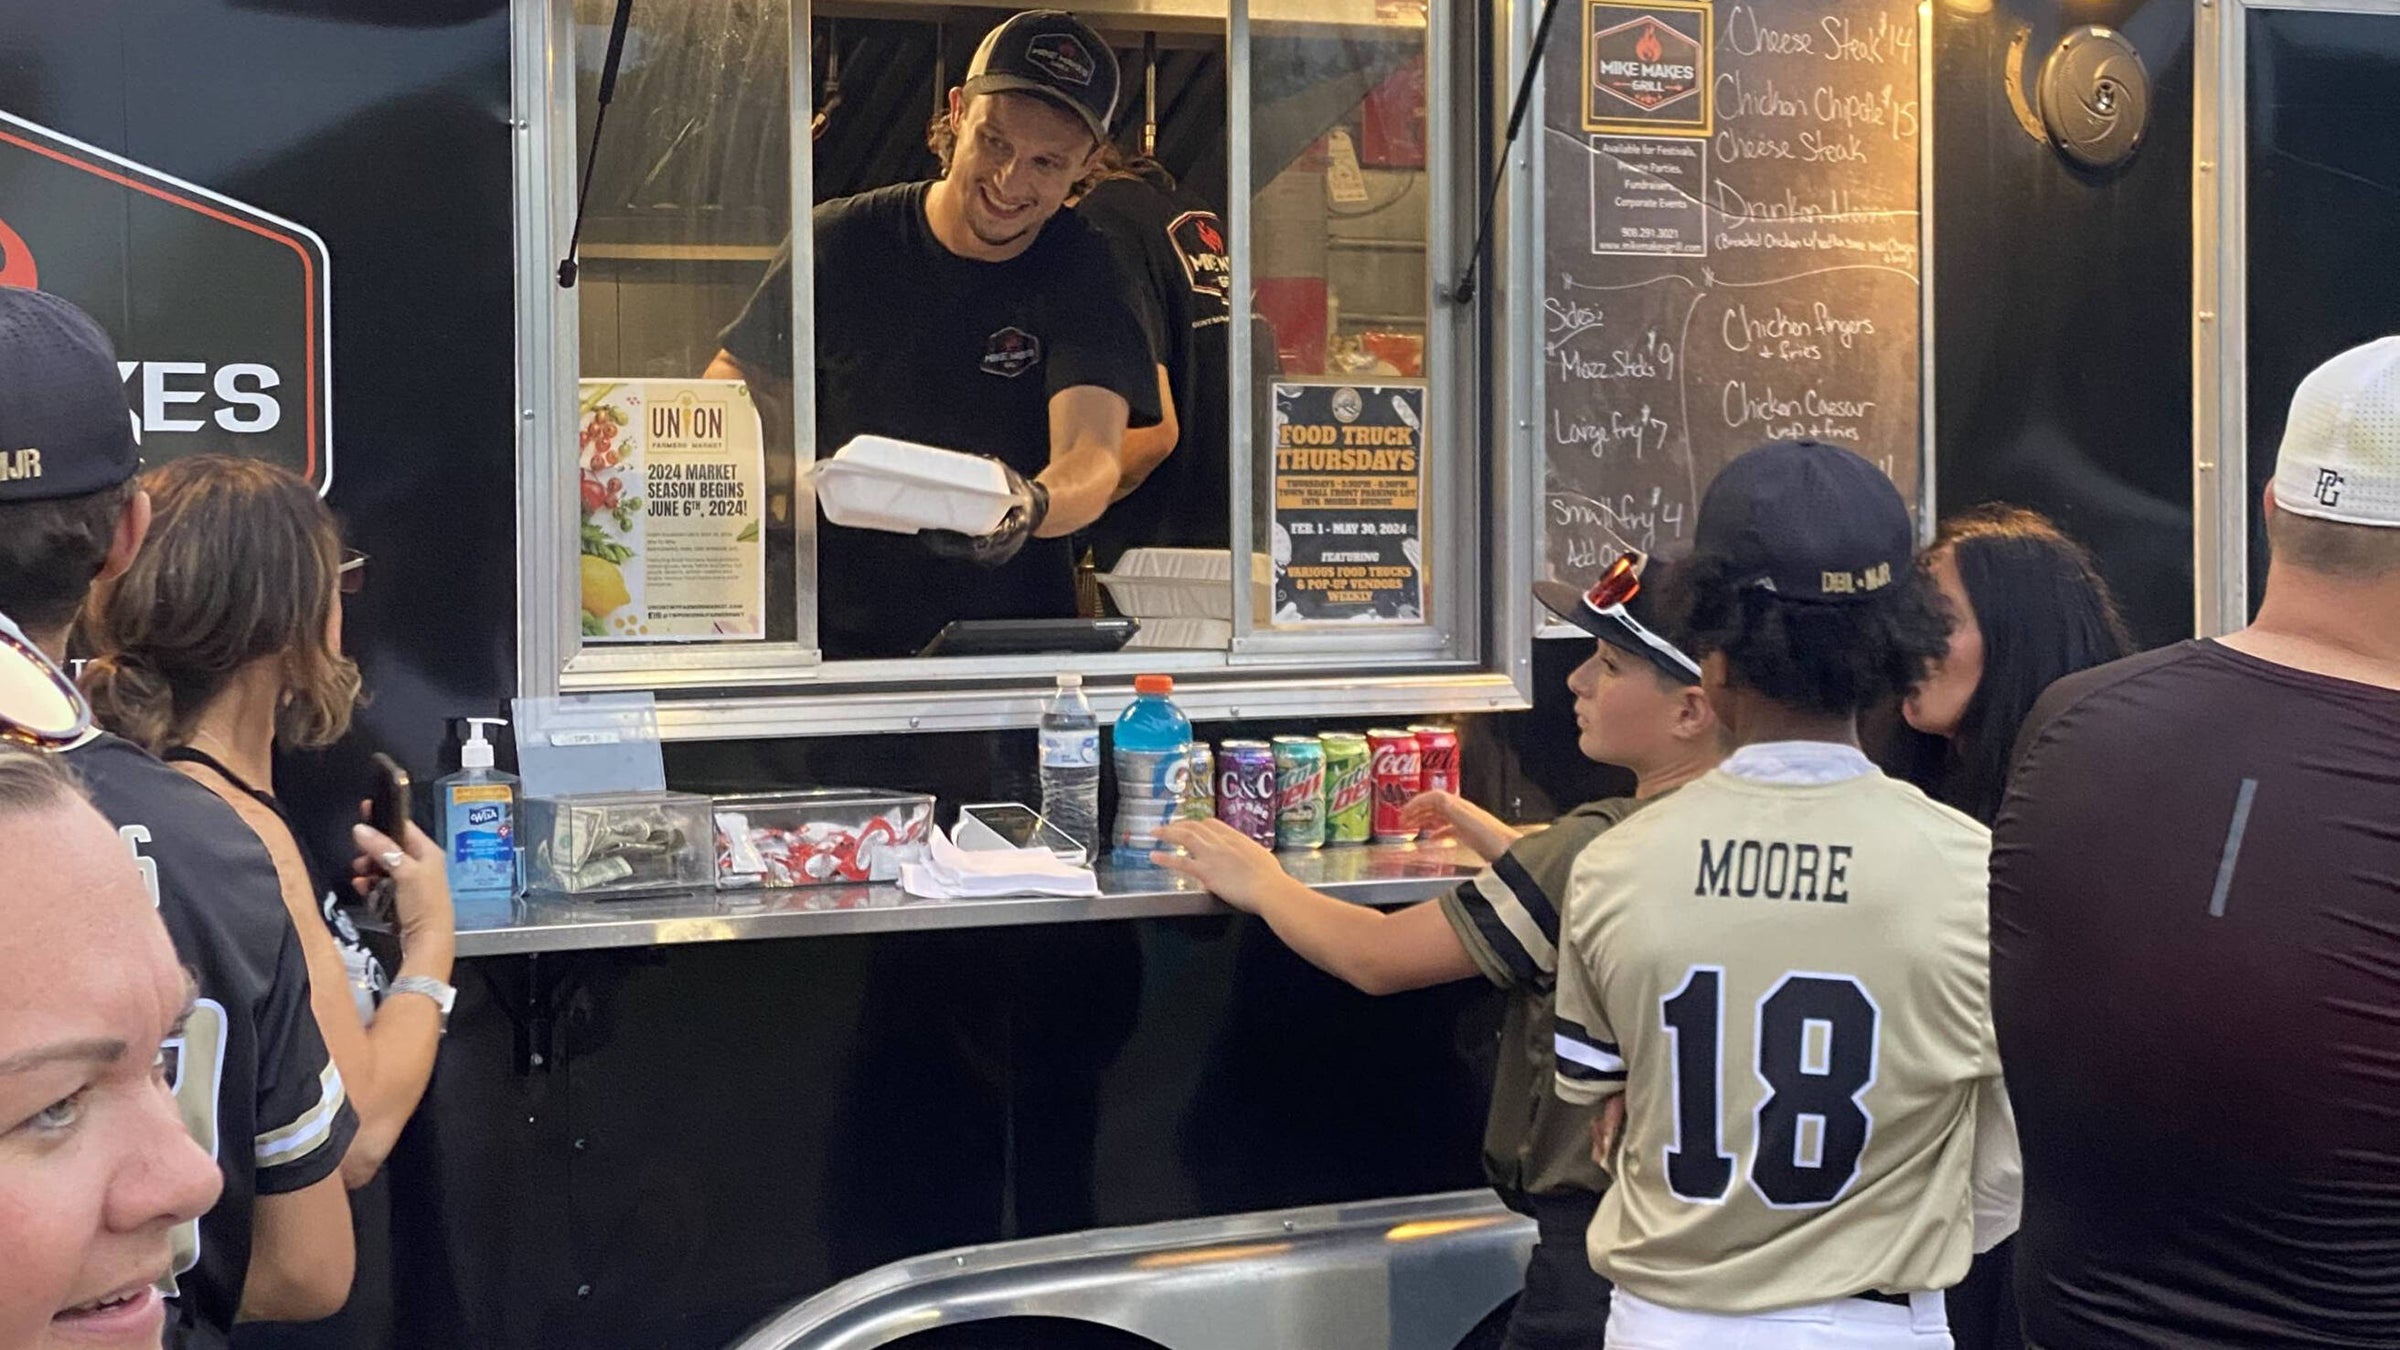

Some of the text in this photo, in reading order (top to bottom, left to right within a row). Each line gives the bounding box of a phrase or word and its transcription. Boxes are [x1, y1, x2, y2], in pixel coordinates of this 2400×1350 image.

[1729, 5, 1814, 56] Cheese
[1821, 16, 1884, 64] Steak
[1600, 60, 1695, 80] MIKE MAKES
[1631, 80, 1665, 92] GRILL
[1715, 128, 1868, 164] Cheese Steak
[1280, 424, 1413, 446] FOOD TRUCK
[1555, 408, 1610, 458] Large
[1278, 448, 1416, 471] THURSDAYS
[648, 464, 737, 480] 2024 MARKET
[648, 482, 744, 498] SEASON BEGINS
[648, 501, 679, 517] JUNE
[709, 500, 748, 517] 2024!
[1552, 497, 1613, 529] Small
[1290, 523, 1315, 535] FEB.
[1318, 523, 1323, 534] 1
[1333, 523, 1358, 535] MAY
[1361, 523, 1377, 536] 30,
[1379, 523, 1408, 535] 2024
[1321, 552, 1380, 563] FEATURING
[1287, 566, 1412, 578] VARIOUS FOOD TRUCKS
[1308, 578, 1347, 590] POP-UP
[1350, 578, 1403, 590] VENDORS
[1326, 590, 1374, 602] WEEKLY
[1694, 838, 1854, 904] MOORE
[1659, 964, 1881, 1210] 18
